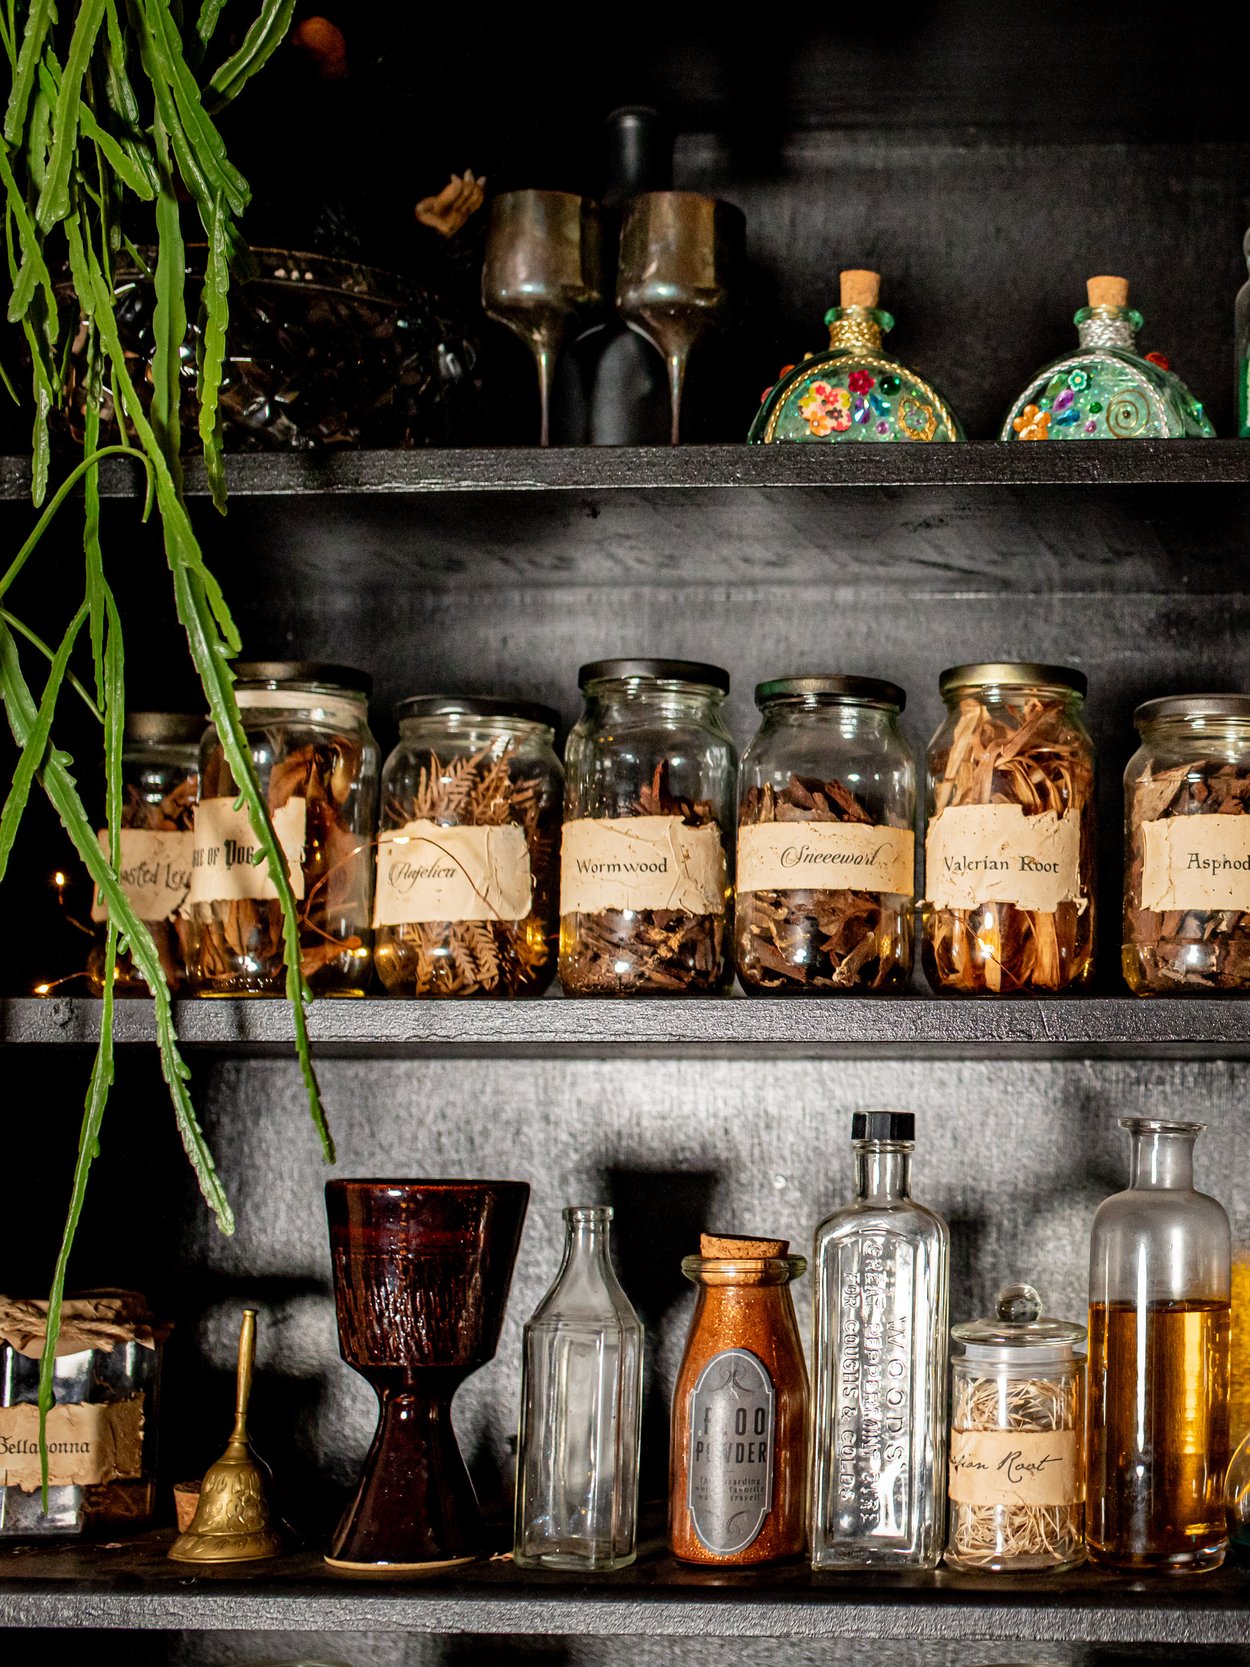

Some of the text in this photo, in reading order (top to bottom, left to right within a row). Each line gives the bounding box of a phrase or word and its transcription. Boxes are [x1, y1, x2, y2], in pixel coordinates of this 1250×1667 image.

[575, 857, 669, 875] Wormwood
[943, 854, 1061, 874] Valerian Root
[838, 1271, 861, 1502] FOR COUGHS & COLDS
[703, 1406, 767, 1436] FOO
[997, 1450, 1064, 1485] Root
